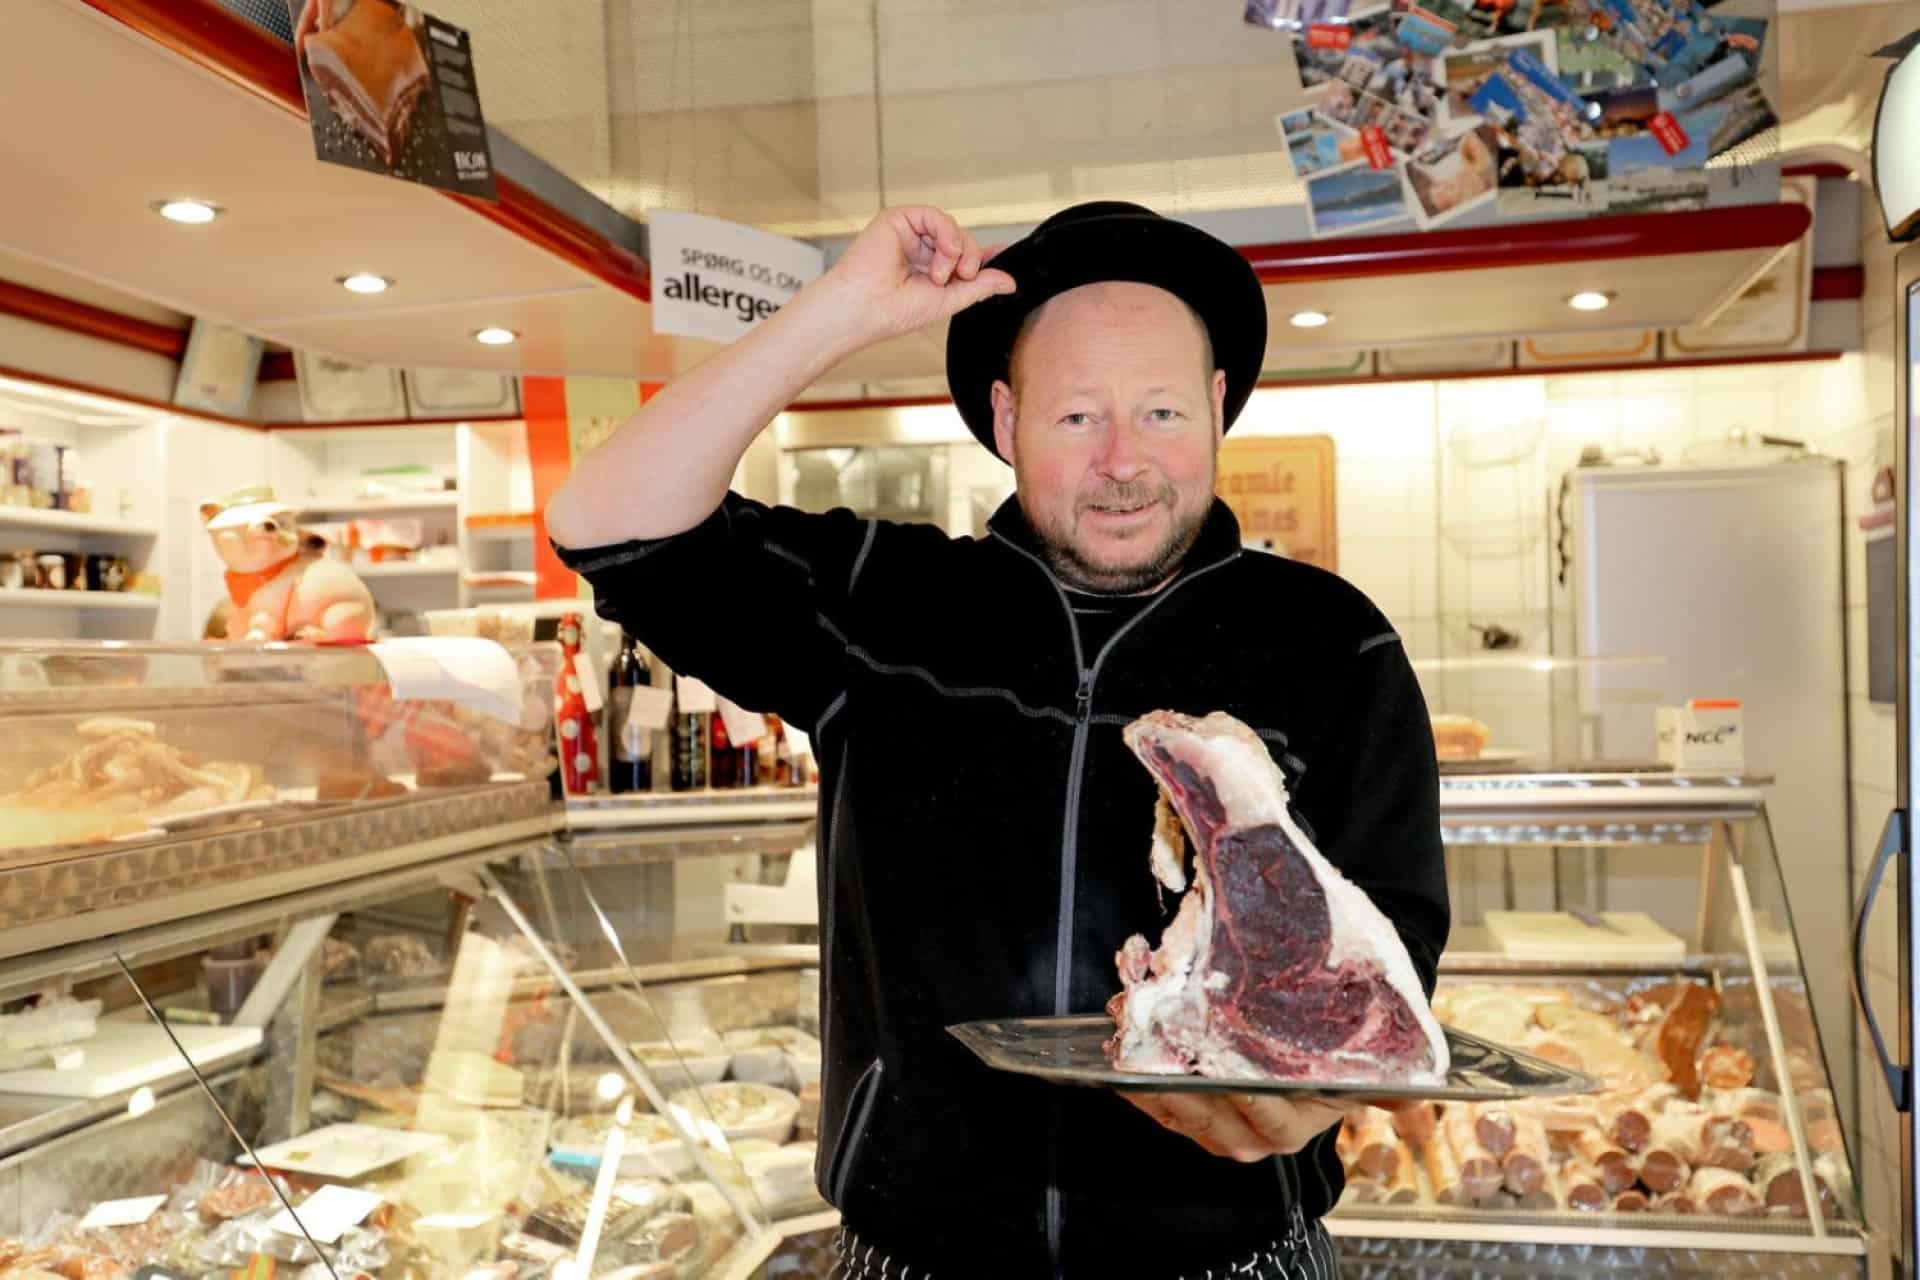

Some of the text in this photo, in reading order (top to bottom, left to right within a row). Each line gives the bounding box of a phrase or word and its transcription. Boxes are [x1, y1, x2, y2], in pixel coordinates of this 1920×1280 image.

[680, 247, 745, 276] SPØRG
[749, 264, 772, 285] OS
[664, 272, 782, 322] allerge
